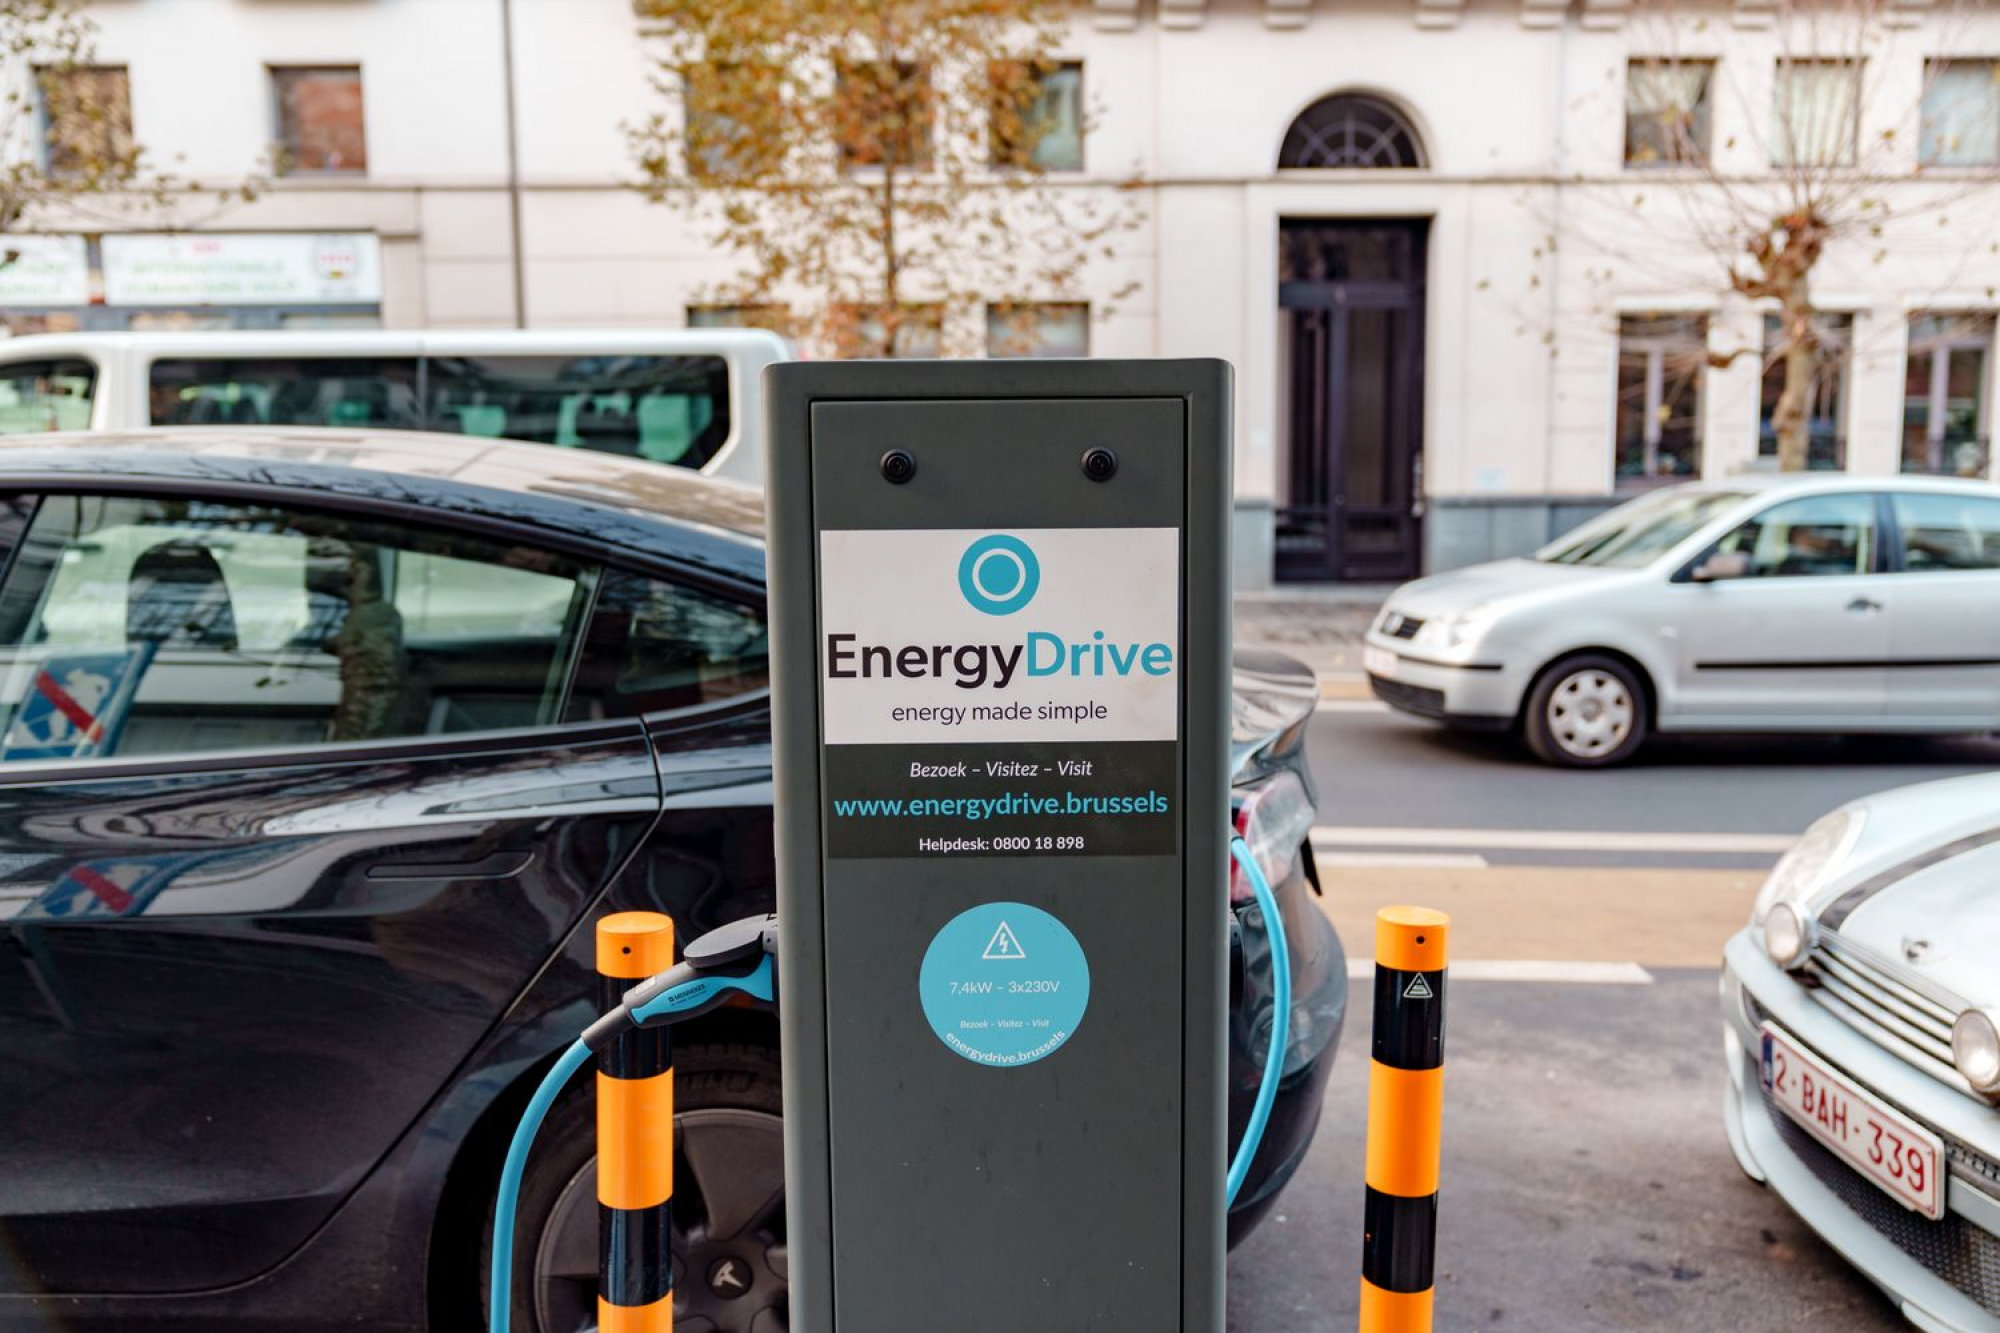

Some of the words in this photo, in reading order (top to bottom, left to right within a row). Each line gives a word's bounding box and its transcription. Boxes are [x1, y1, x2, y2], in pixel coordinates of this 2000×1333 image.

[828, 631, 1173, 689] EnergyDrive
[892, 705, 966, 726] energy
[972, 701, 1033, 721] made
[1038, 700, 1108, 724] simple
[910, 762, 967, 778] Bezoek
[986, 761, 1039, 777] Visitez
[1057, 760, 1093, 776] Visit
[834, 790, 1169, 820] www.energydrive.brussels
[919, 837, 990, 853] Helpdesk:
[993, 837, 1031, 850] 0800
[1034, 837, 1053, 850] 18
[1056, 836, 1085, 850] 898
[1008, 980, 1060, 993] 3x230V
[946, 1030, 1065, 1063] energydrive.brussels
